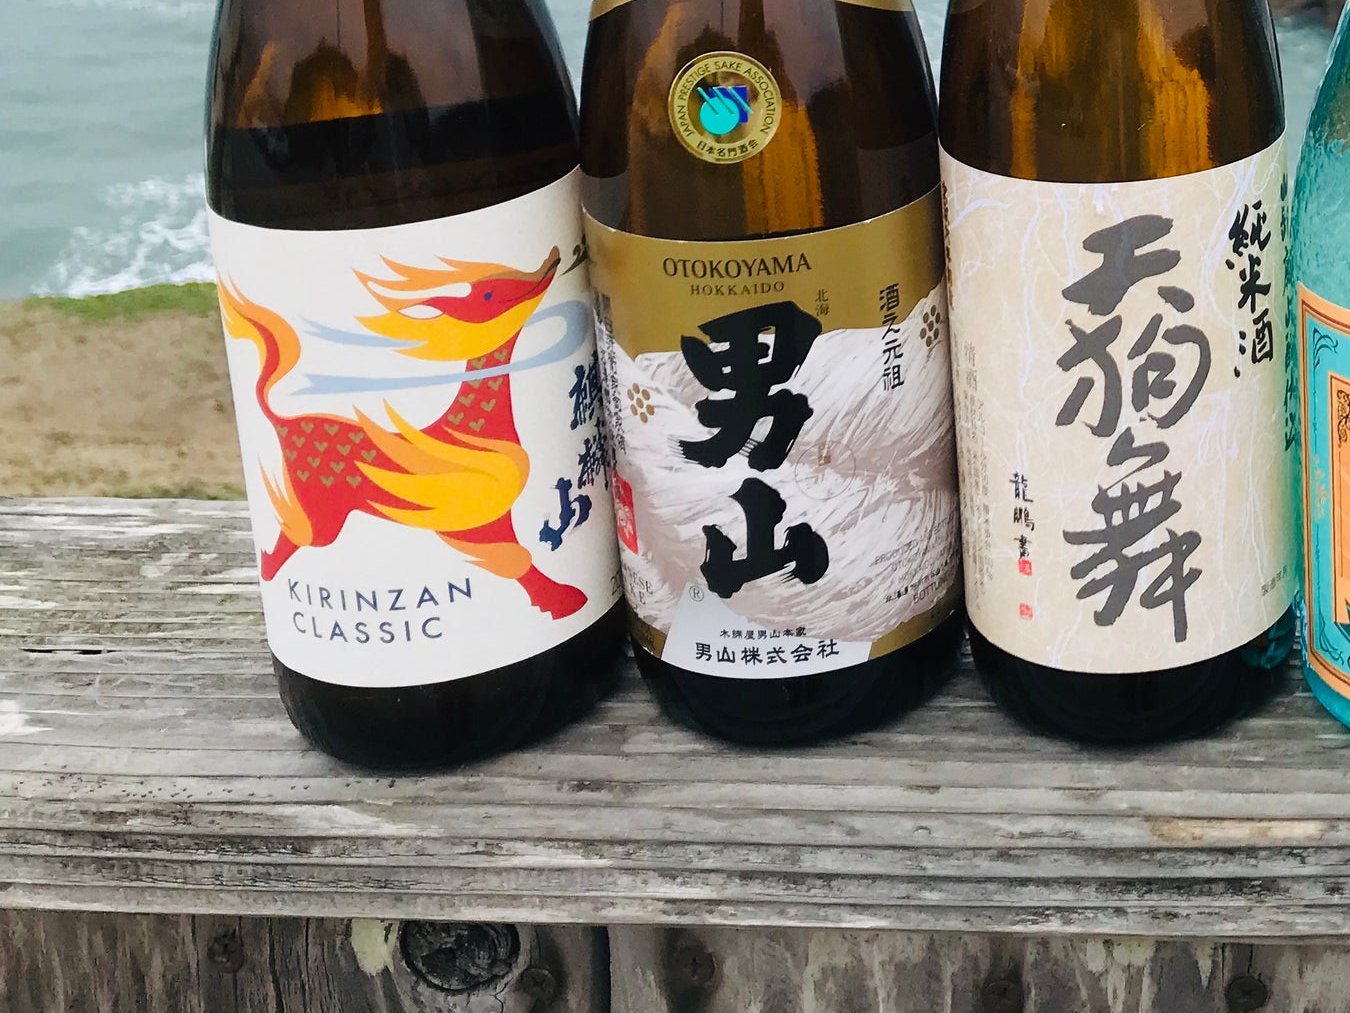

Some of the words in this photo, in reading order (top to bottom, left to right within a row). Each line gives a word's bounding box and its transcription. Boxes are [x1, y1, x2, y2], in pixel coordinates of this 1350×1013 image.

[714, 60, 742, 71] SAKE
[678, 63, 712, 101] PRESTIGE
[743, 67, 776, 135] ASSOCIATION
[677, 105, 696, 137] JAPAN
[663, 252, 812, 279] OTOKOYAMA
[690, 281, 785, 296] HOKKAIDO
[1224, 199, 1275, 378] 純米酒
[1055, 214, 1212, 643] 天狗舞
[677, 300, 831, 599] 男山
[287, 578, 472, 611] KIRINZAN
[293, 612, 443, 644] CLASSIC
[695, 638, 840, 666] 男山株式会社
